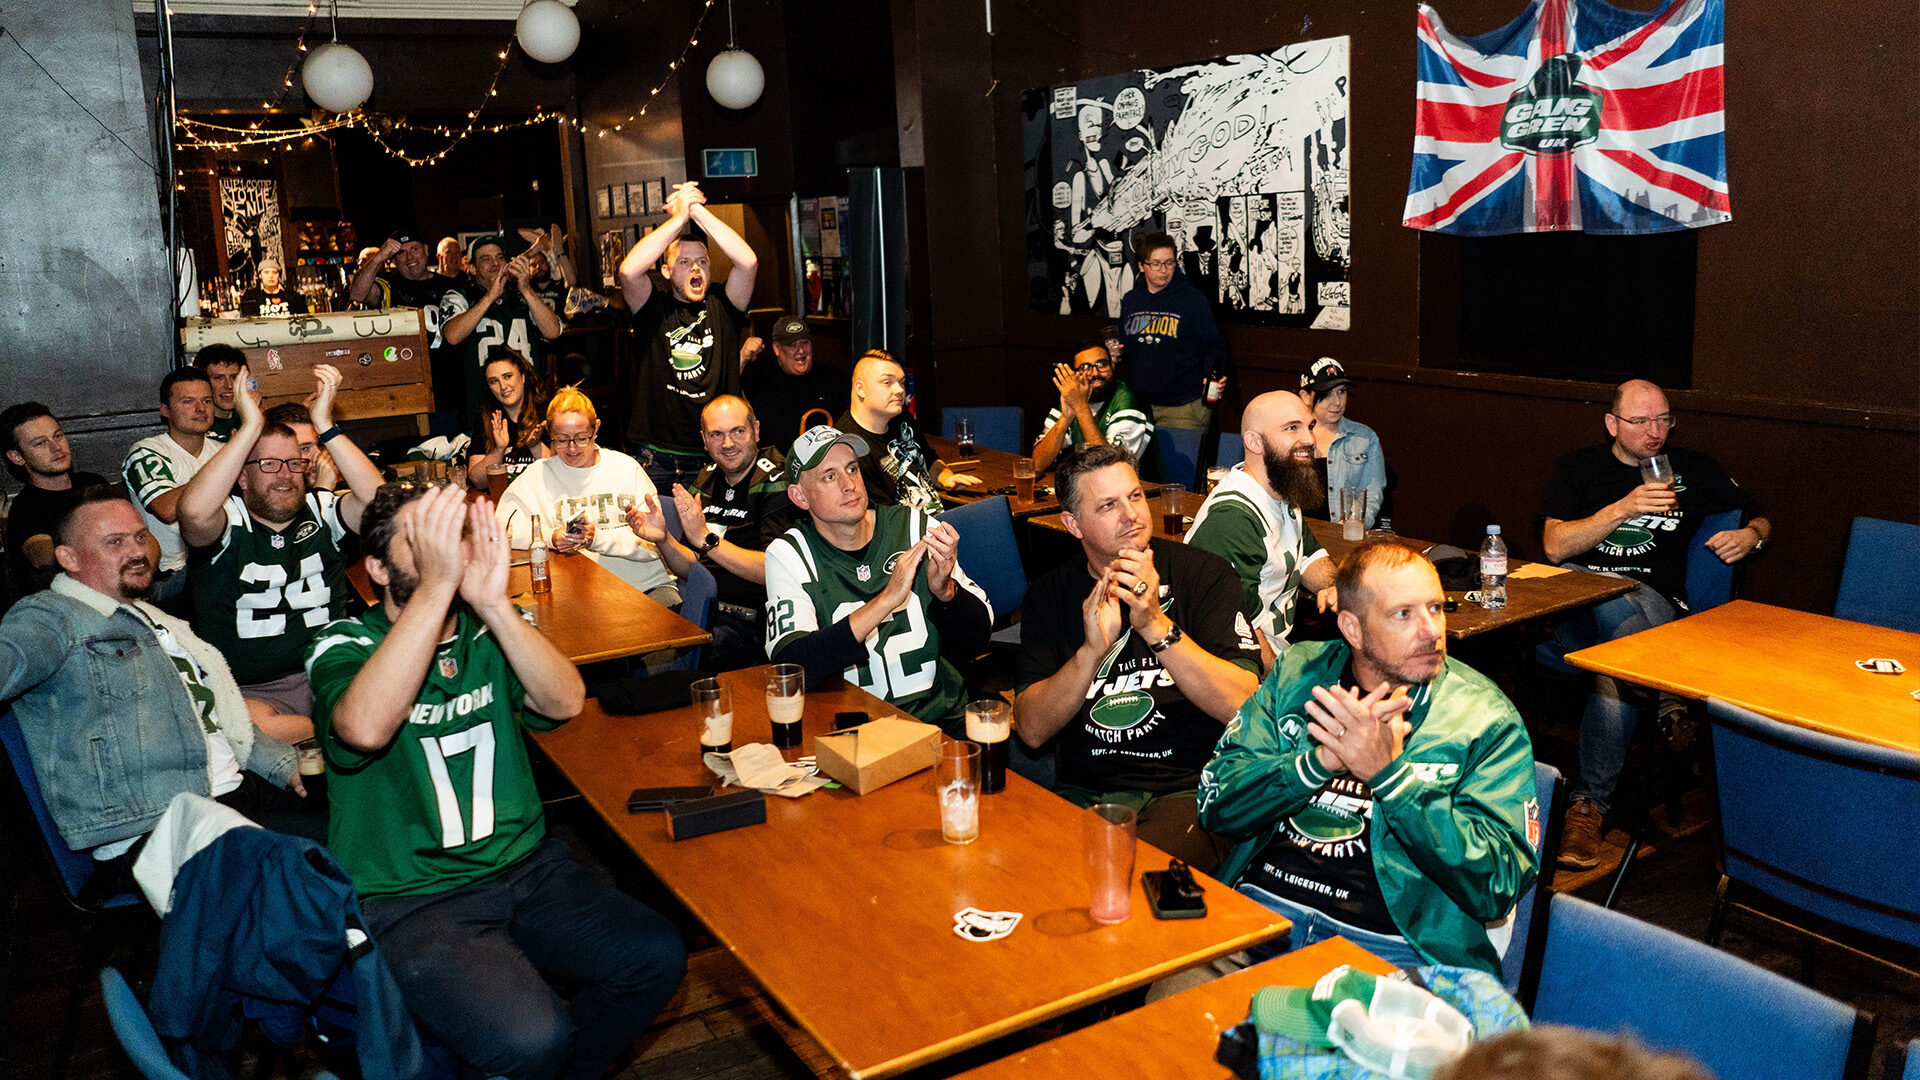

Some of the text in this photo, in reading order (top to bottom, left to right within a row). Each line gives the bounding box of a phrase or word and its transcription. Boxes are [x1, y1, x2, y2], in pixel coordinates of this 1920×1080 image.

[1538, 138, 1569, 148] UK
[476, 318, 534, 367] 24
[683, 364, 706, 380] PARTY
[134, 456, 170, 484] 12
[1626, 541, 1657, 557] PARTY
[235, 552, 333, 639] 24
[767, 599, 795, 642] 82
[1103, 668, 1175, 696] JETS
[445, 682, 494, 722] YORK
[1084, 709, 1166, 743] WATCH PARTY
[1162, 748, 1173, 758] UK
[419, 721, 496, 849] 17
[1331, 778, 1364, 795] TAKE
[1310, 838, 1367, 858] PARTY
[1284, 872, 1333, 897] LEICESTER,
[1335, 888, 1350, 900] UK
